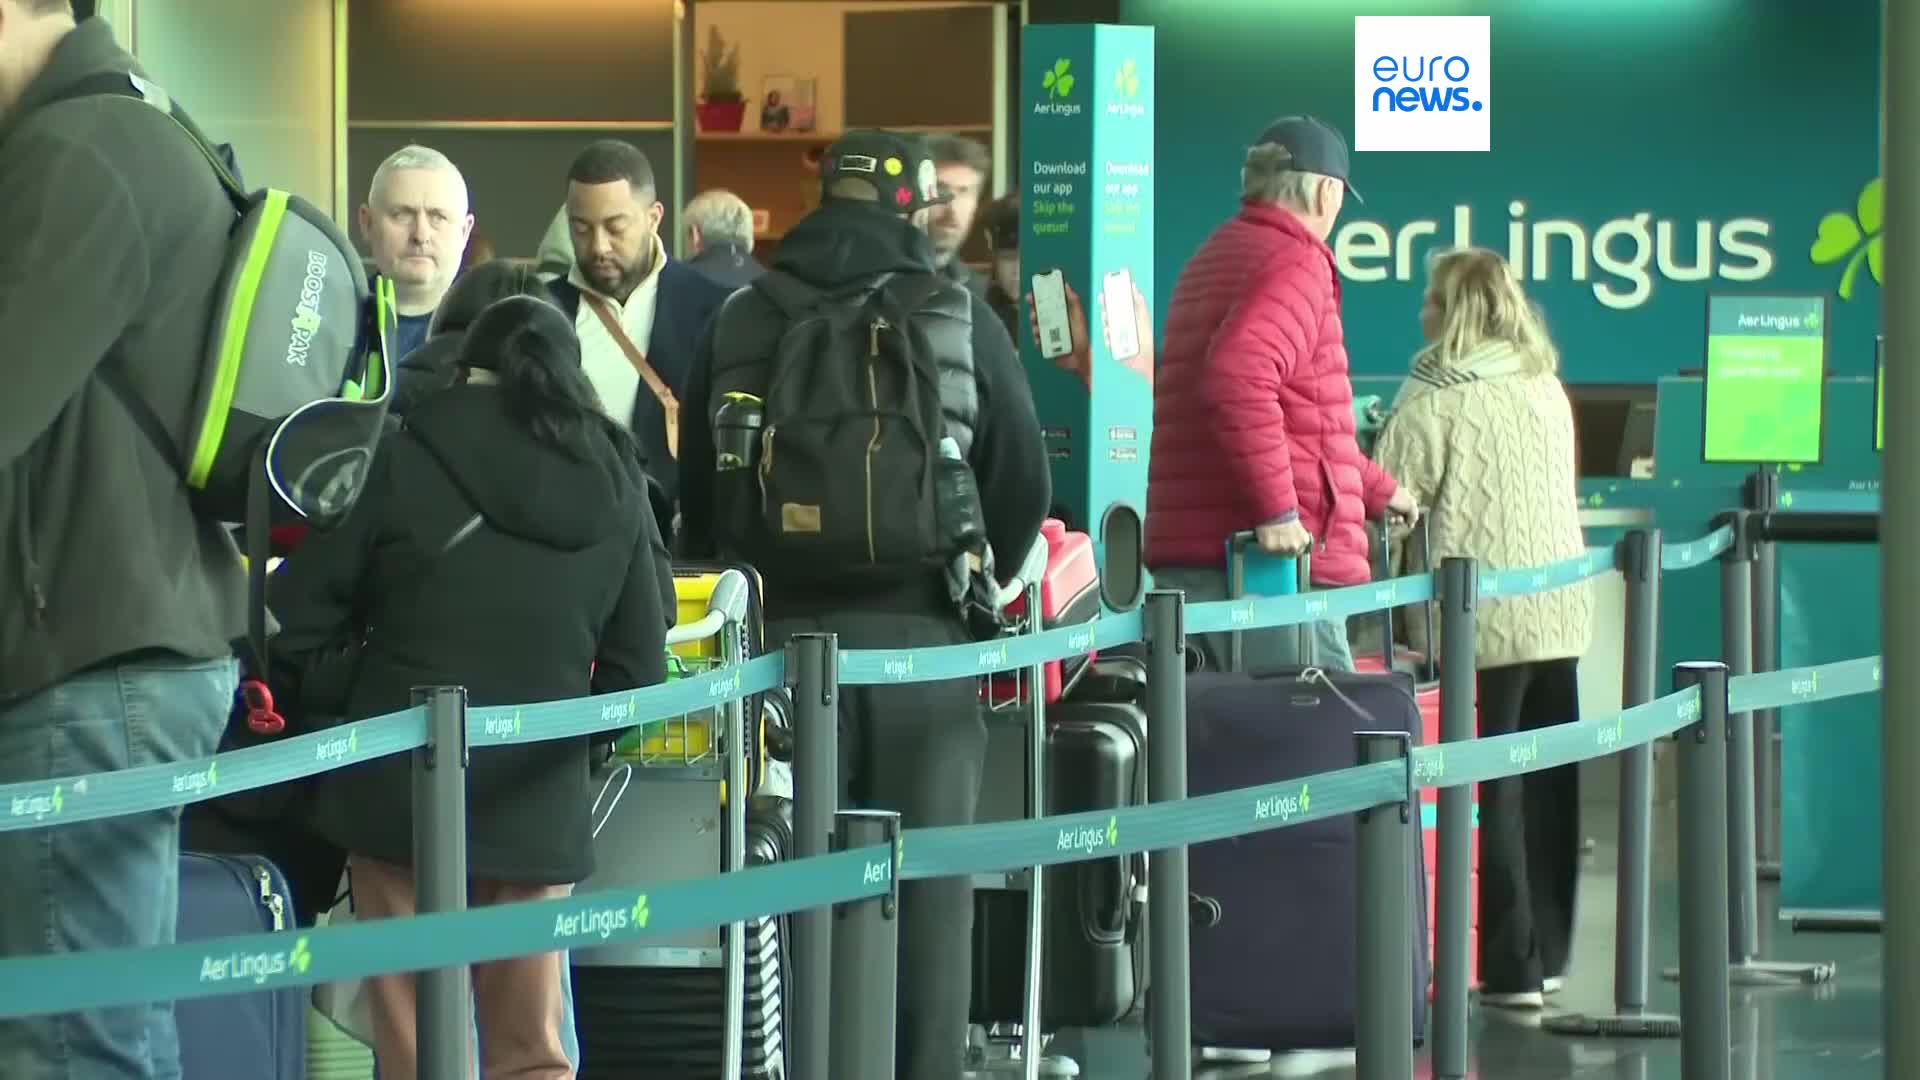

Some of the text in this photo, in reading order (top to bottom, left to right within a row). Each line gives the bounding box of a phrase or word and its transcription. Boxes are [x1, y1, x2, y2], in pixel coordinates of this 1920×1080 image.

[1033, 161, 1086, 175] Download
[1033, 184, 1073, 197] our app
[1033, 201, 1056, 216] Skip
[1334, 219, 1438, 282] er
[1255, 795, 1297, 821] Aer Lingus
[1057, 825, 1104, 854] Aer Lingus
[863, 861, 886, 885] Aer
[553, 908, 627, 939] Aer Lingus
[201, 951, 286, 984] Aer Lingus
